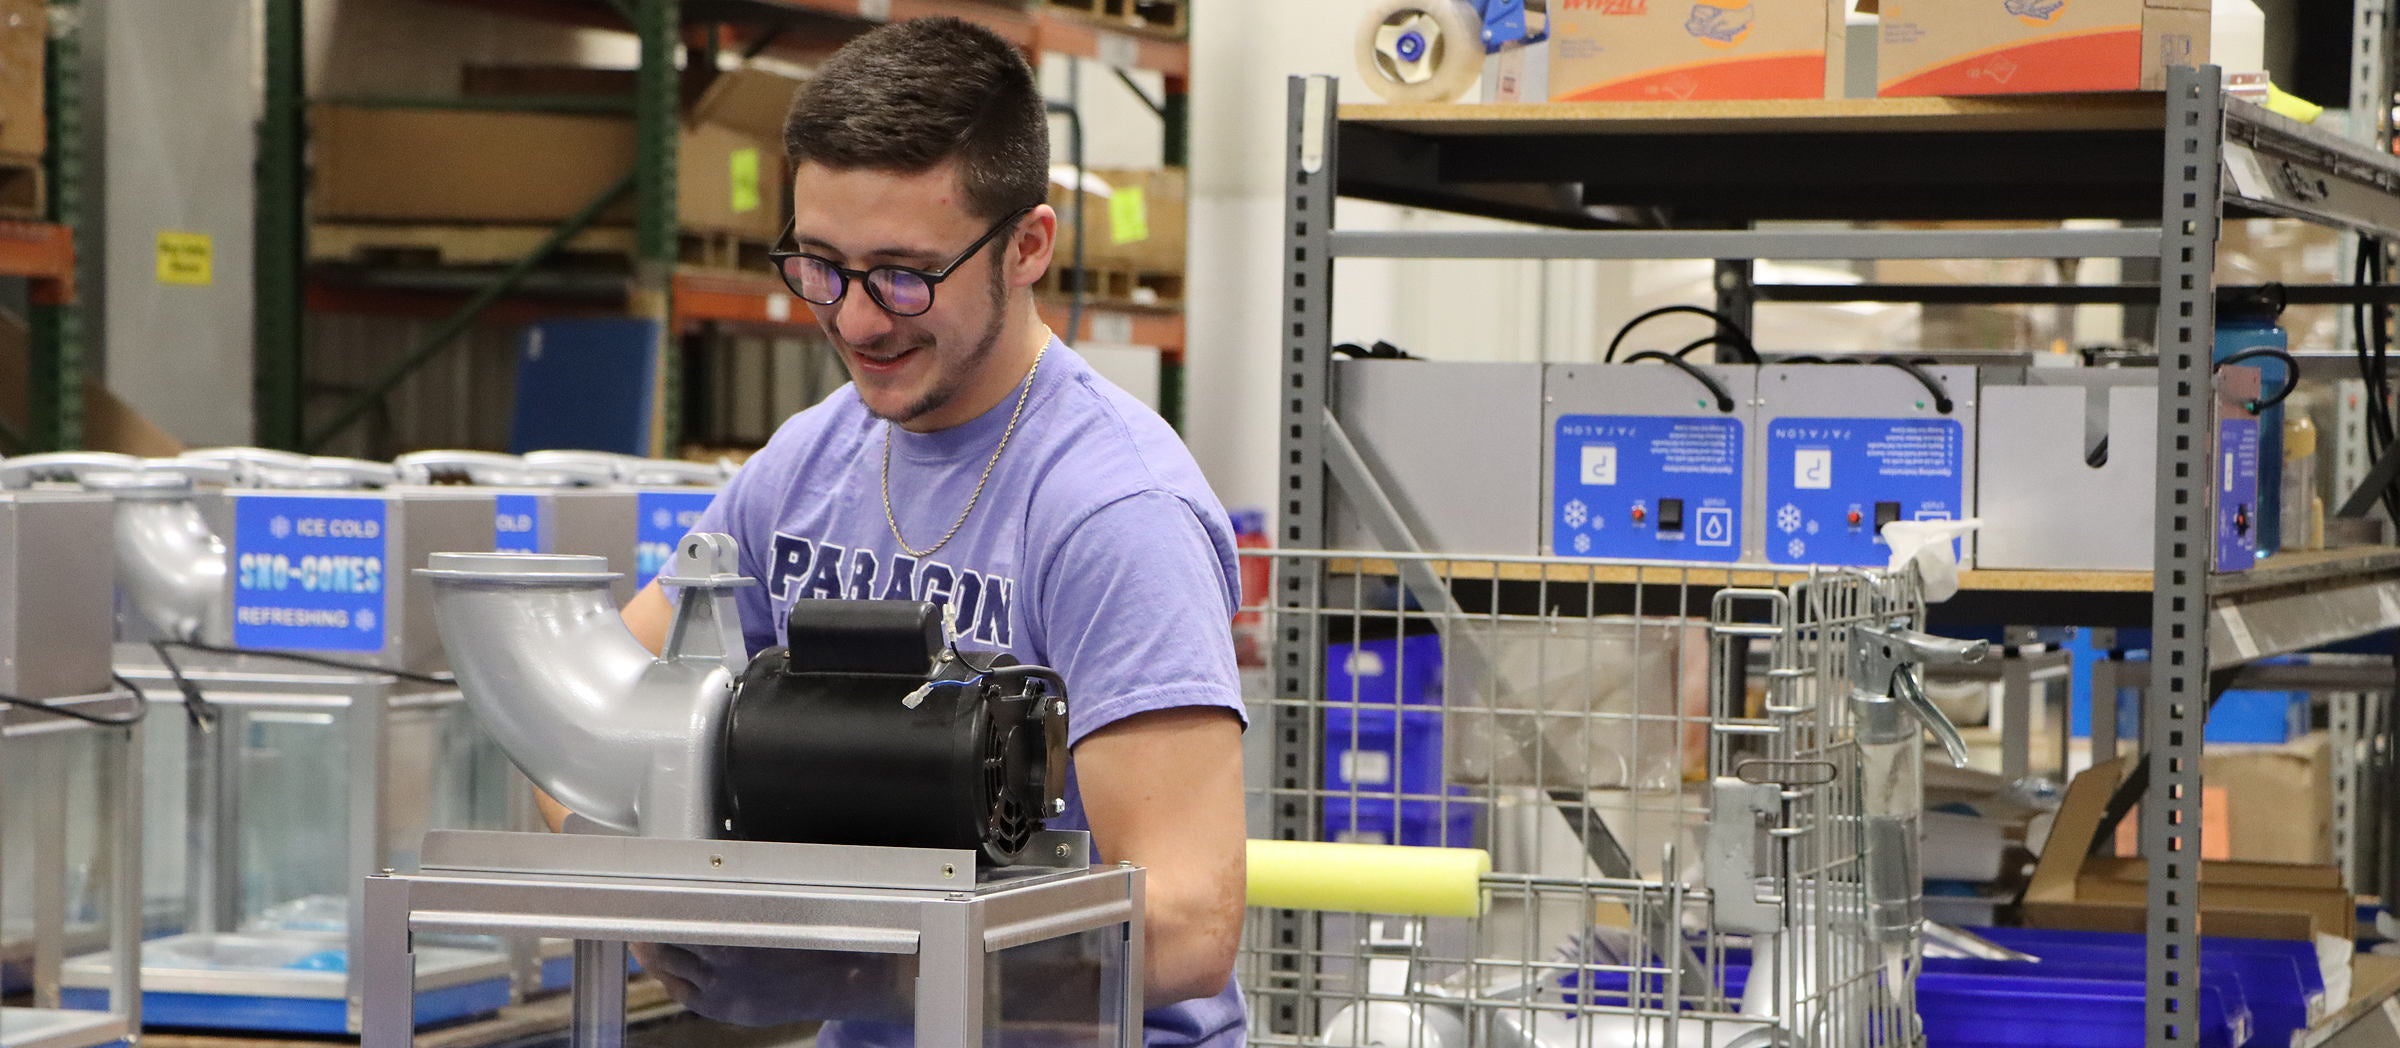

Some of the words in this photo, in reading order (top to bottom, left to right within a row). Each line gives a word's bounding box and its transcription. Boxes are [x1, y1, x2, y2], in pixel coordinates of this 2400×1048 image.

[297, 518, 327, 537] ICE
[329, 519, 380, 538] COLD
[496, 514, 532, 532] OLD
[768, 531, 1014, 648] PARAGON
[238, 606, 349, 629] REFRESHING
